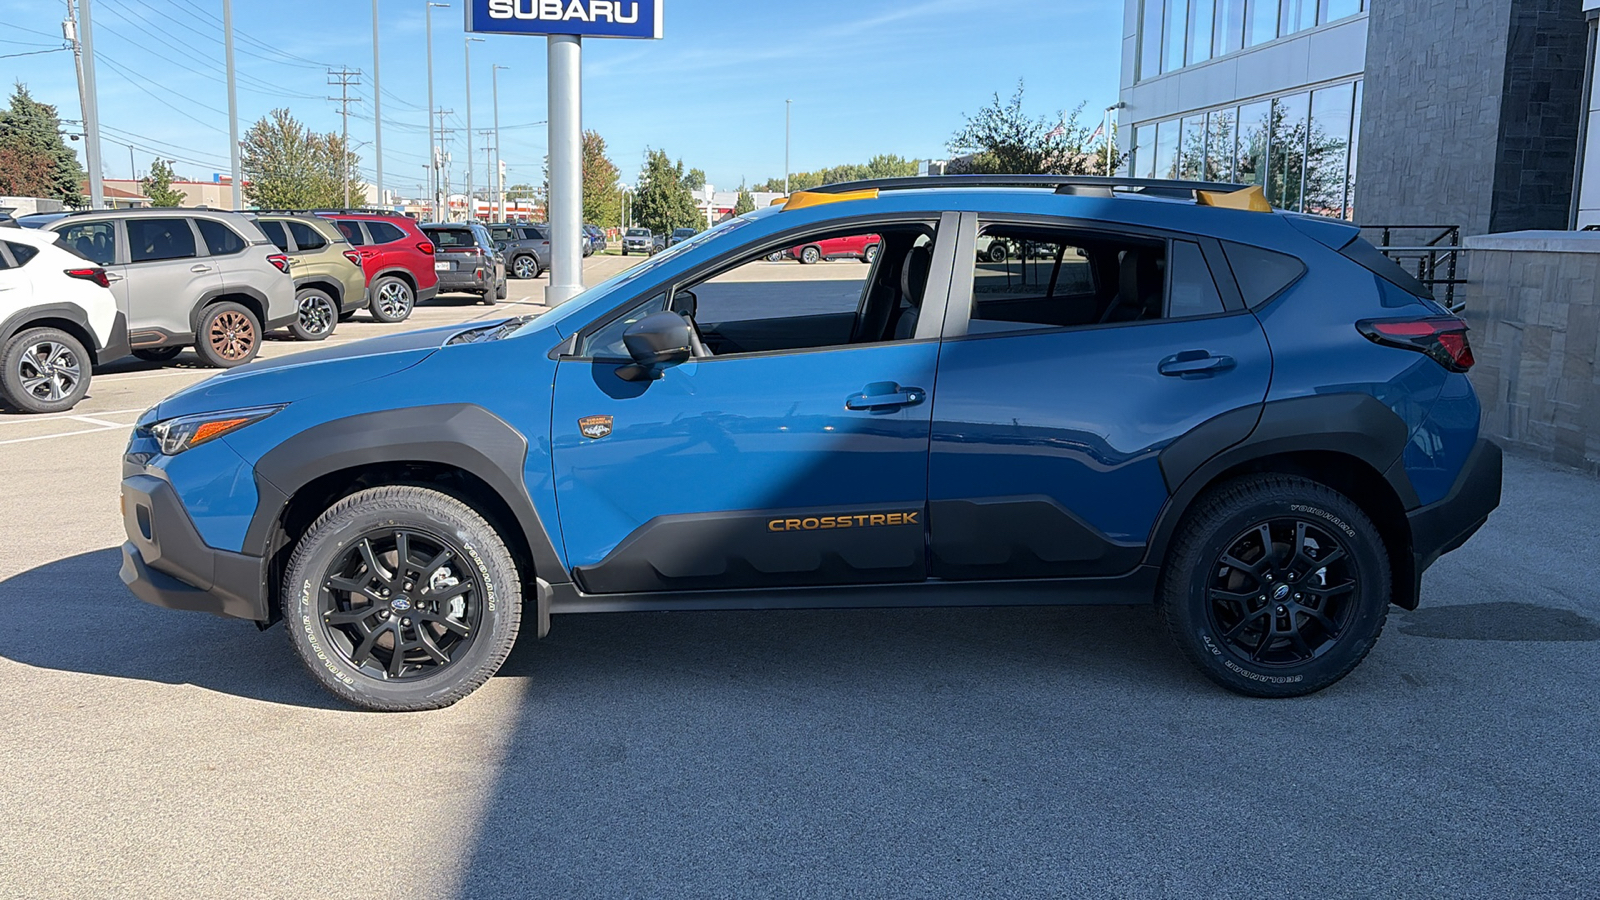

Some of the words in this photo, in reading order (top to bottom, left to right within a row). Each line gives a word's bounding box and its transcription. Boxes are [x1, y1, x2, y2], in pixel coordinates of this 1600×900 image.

[488, 0, 638, 24] SUBARU
[768, 512, 919, 532] CROSSTREK
[1290, 504, 1356, 538] YOKOHAMA
[463, 542, 495, 612] YOKOHAMA
[302, 615, 354, 685] GEOLANDAR
[1202, 635, 1222, 656] A/T
[1224, 659, 1303, 684] GEOLANDAR
